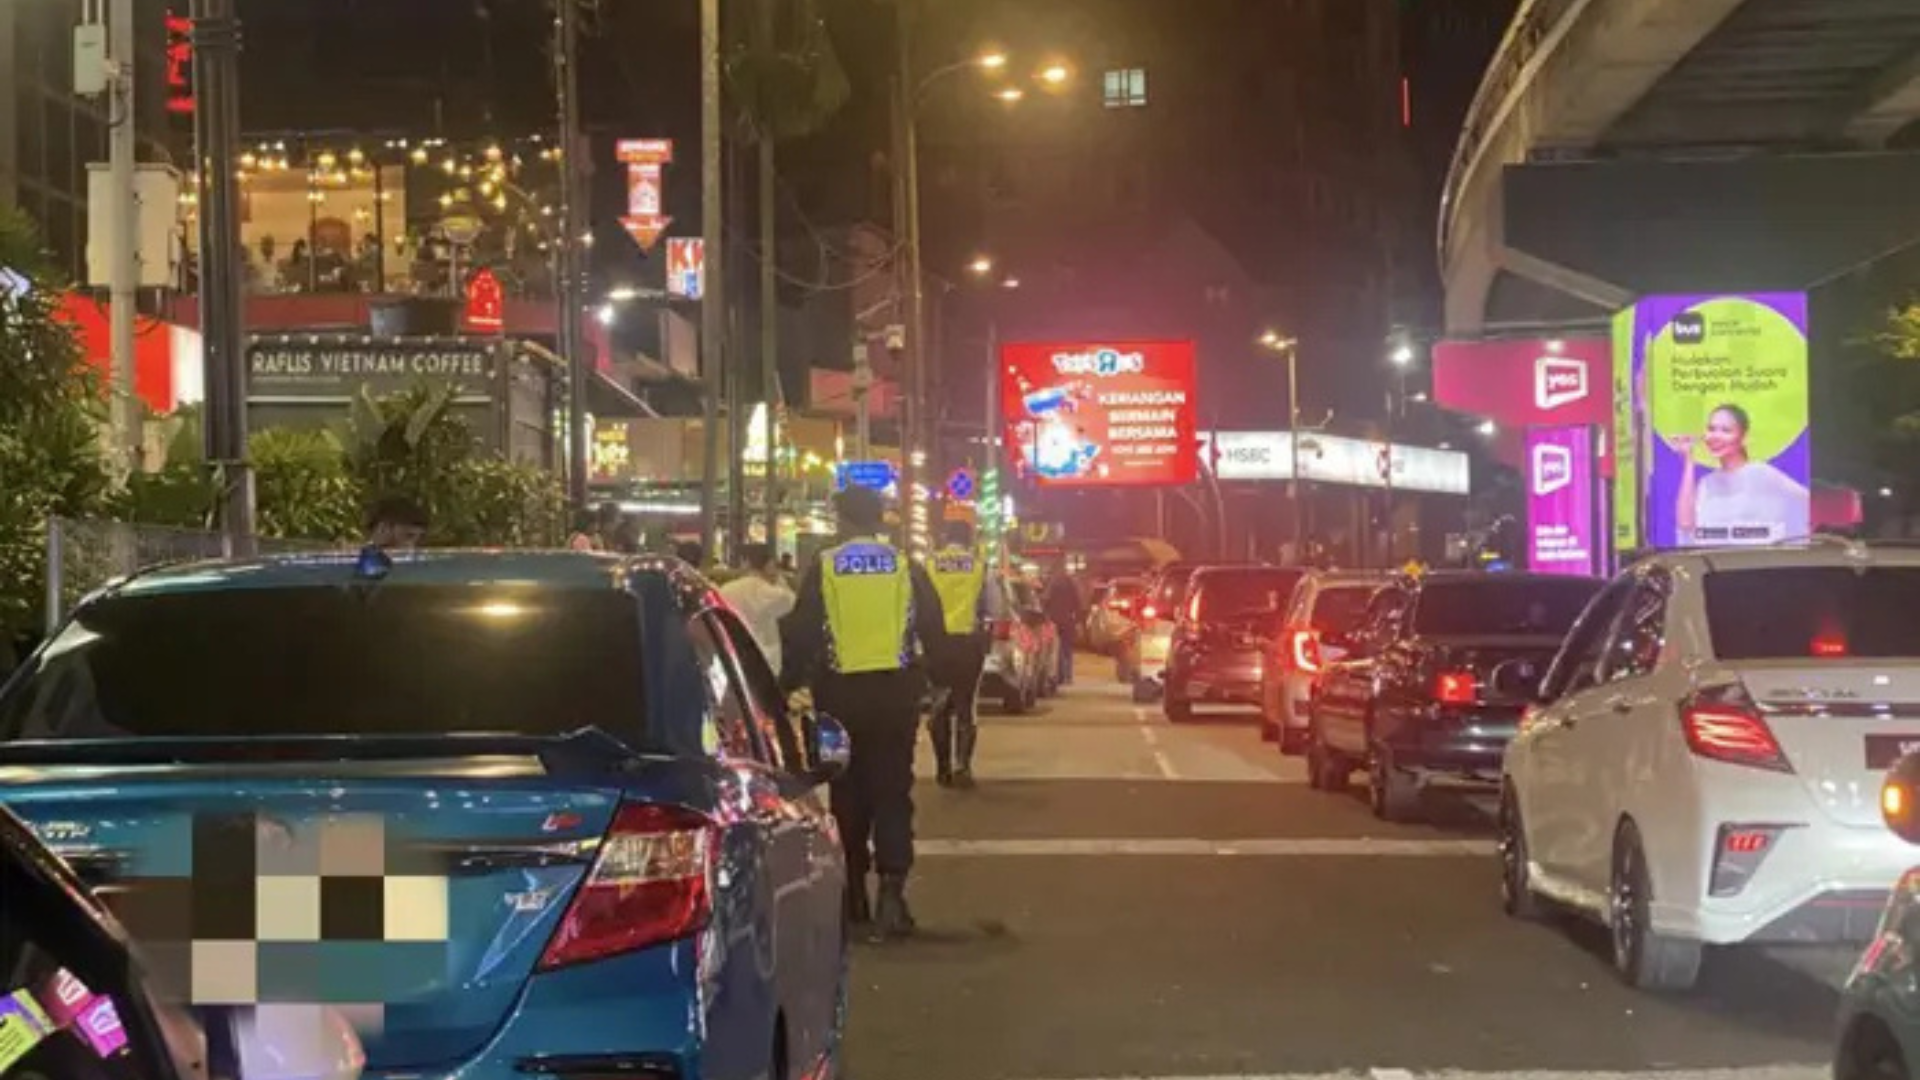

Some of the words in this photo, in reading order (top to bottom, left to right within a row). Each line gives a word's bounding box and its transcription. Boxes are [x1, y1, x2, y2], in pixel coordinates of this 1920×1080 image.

[320, 352, 405, 373] VIETNAM
[411, 352, 482, 373] COFFEE
[1227, 447, 1271, 464] HSBC
[836, 555, 896, 573] POLIS
